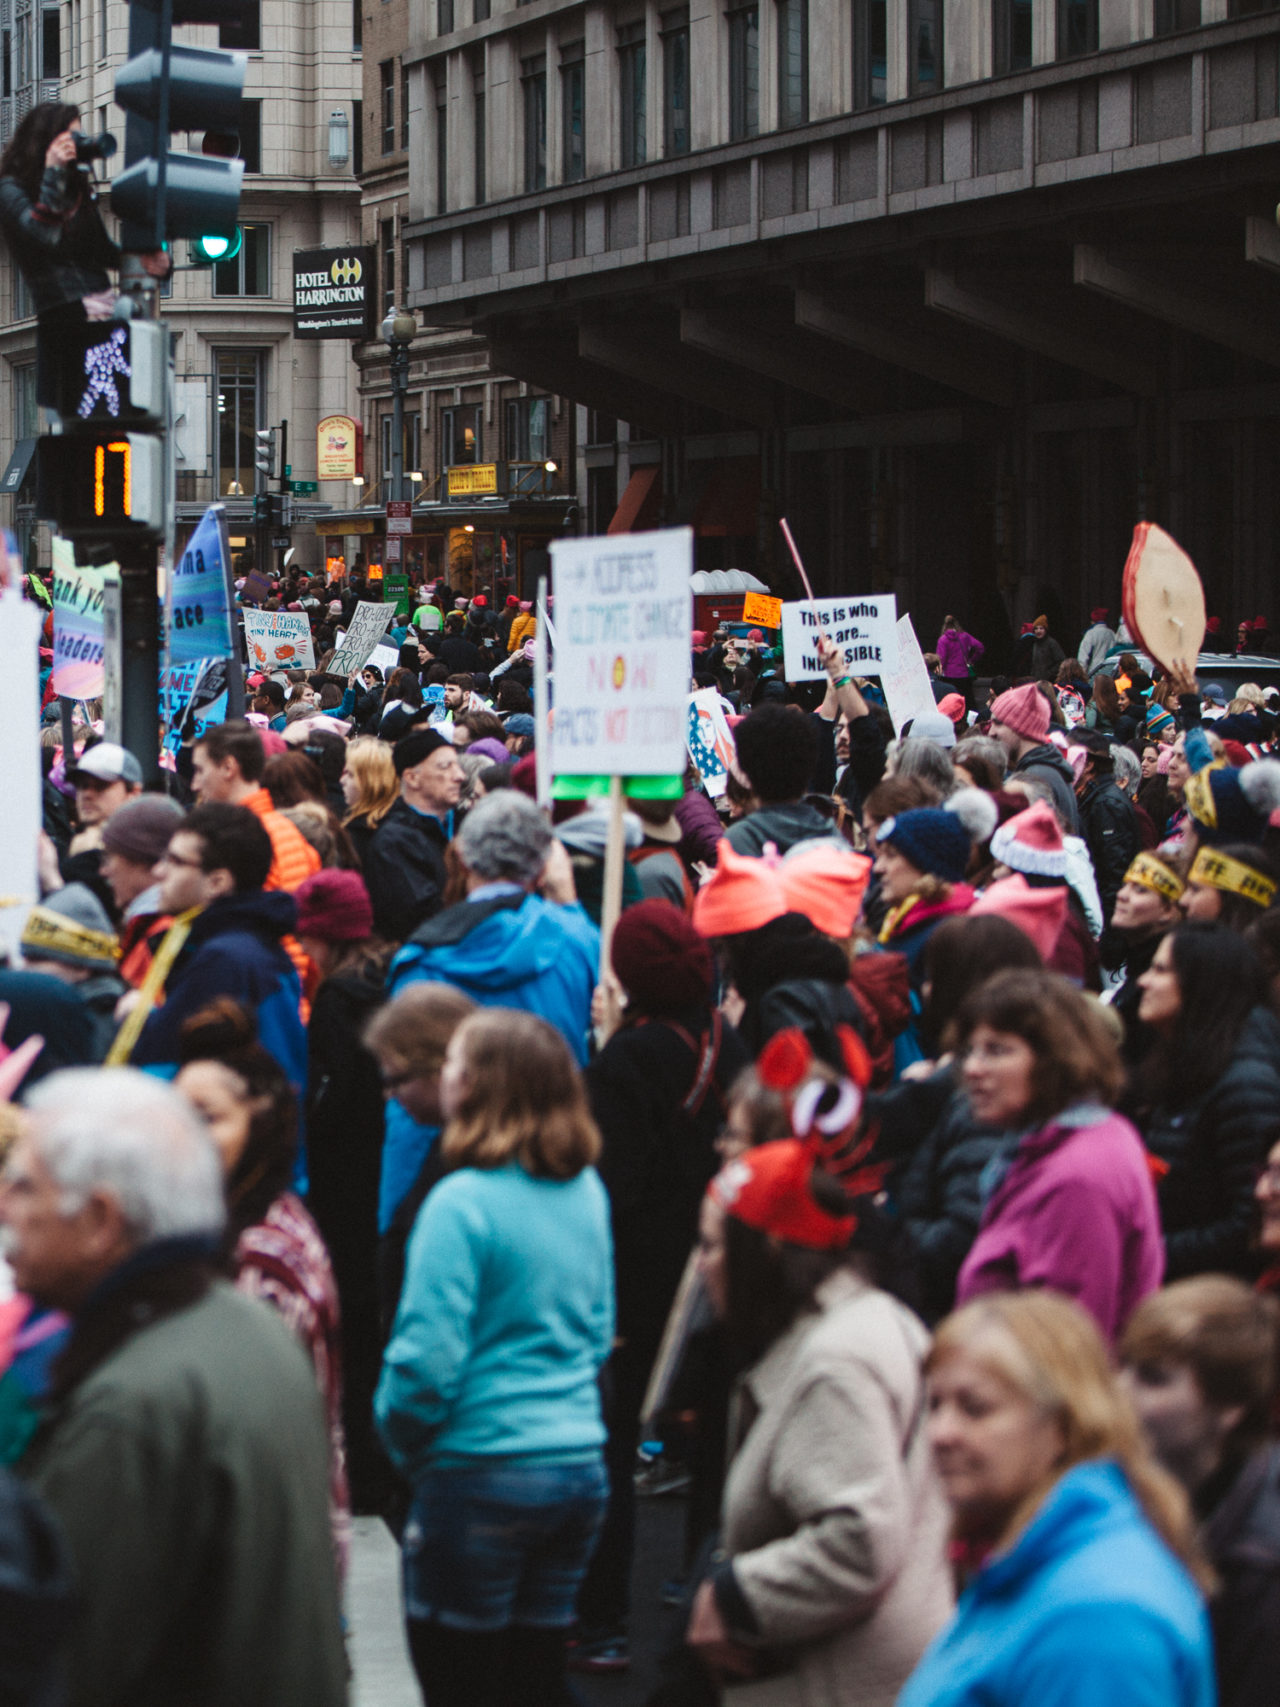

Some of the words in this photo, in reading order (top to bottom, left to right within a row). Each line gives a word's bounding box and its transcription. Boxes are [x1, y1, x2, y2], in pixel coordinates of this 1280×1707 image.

[295, 271, 332, 288] HOTEL
[295, 286, 365, 306] HARRINGTON
[94, 441, 132, 516] 17
[799, 610, 830, 627] This
[833, 608, 846, 623] is
[848, 602, 879, 619] who
[250, 628, 265, 637] TINY
[268, 629, 298, 640] HEART
[801, 645, 883, 672] INDSIBLE
